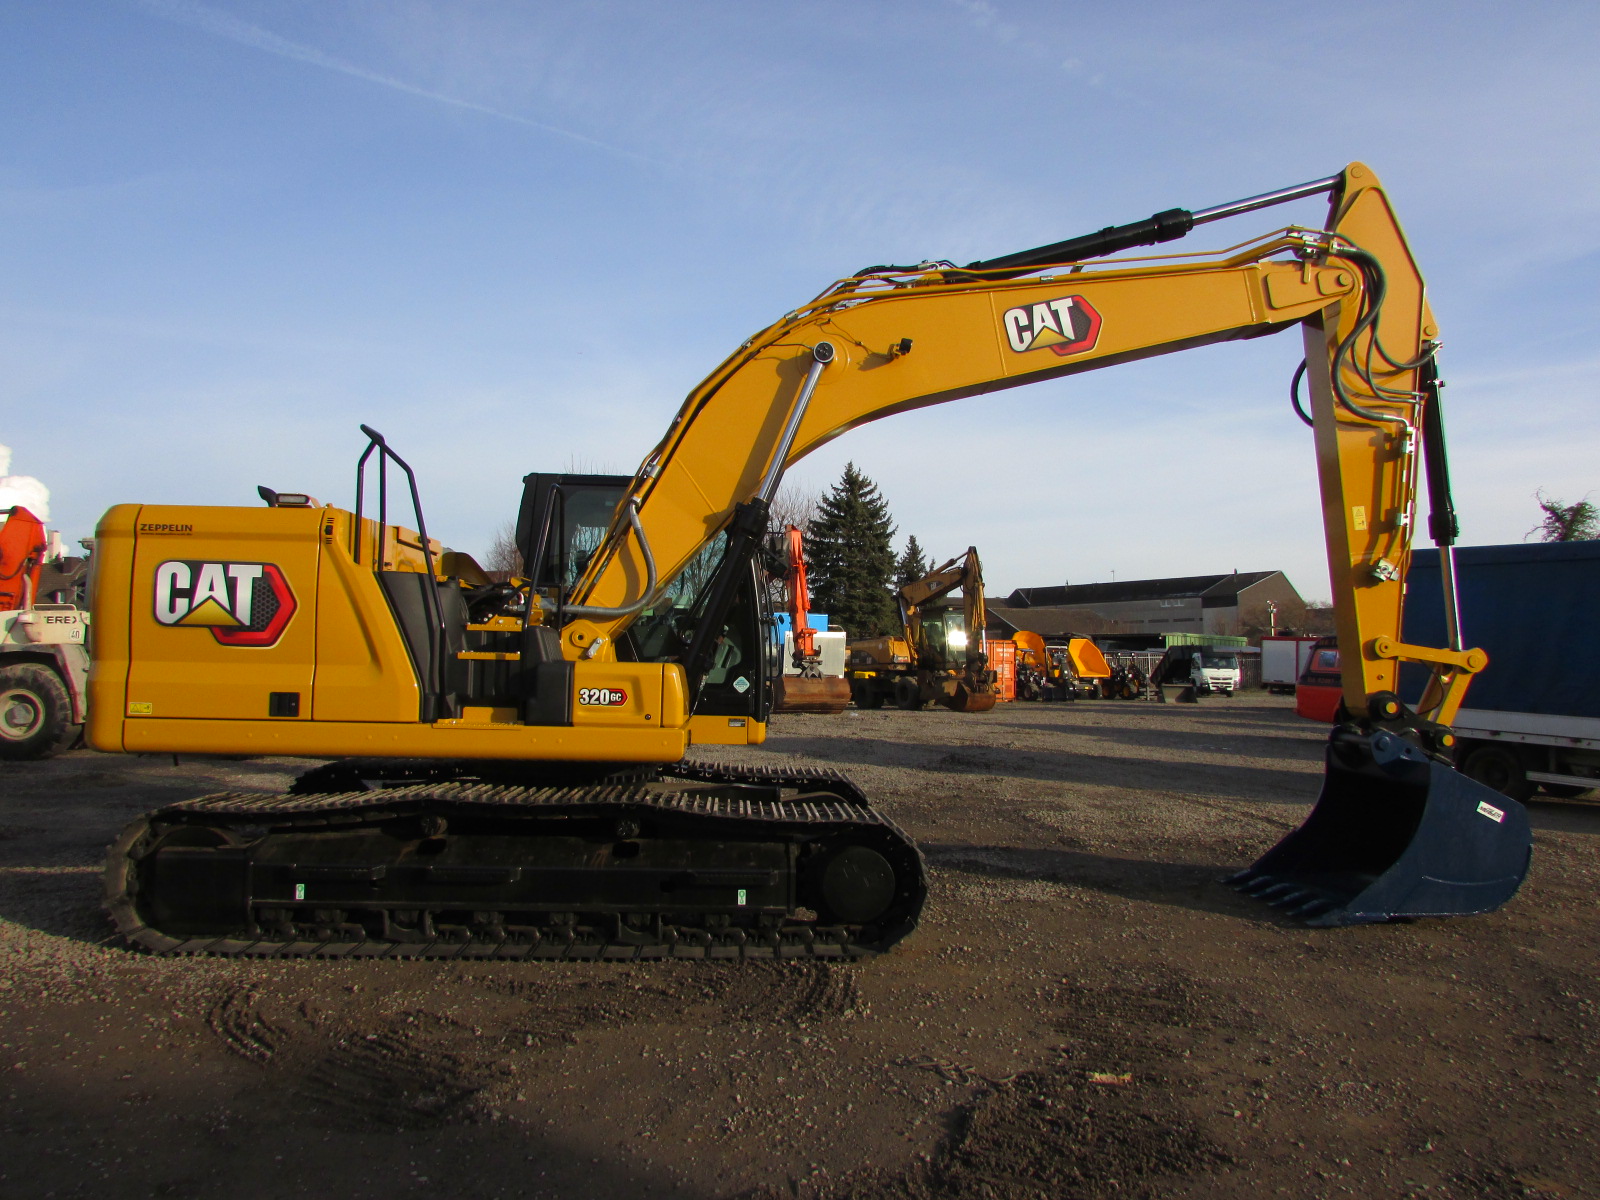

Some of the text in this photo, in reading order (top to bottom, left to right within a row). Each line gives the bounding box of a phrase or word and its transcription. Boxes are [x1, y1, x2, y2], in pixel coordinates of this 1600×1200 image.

[1003, 297, 1076, 352] CAT
[139, 523, 193, 532] ZEPPELIN
[156, 561, 263, 627] CAT
[579, 688, 622, 705] 320 GC
